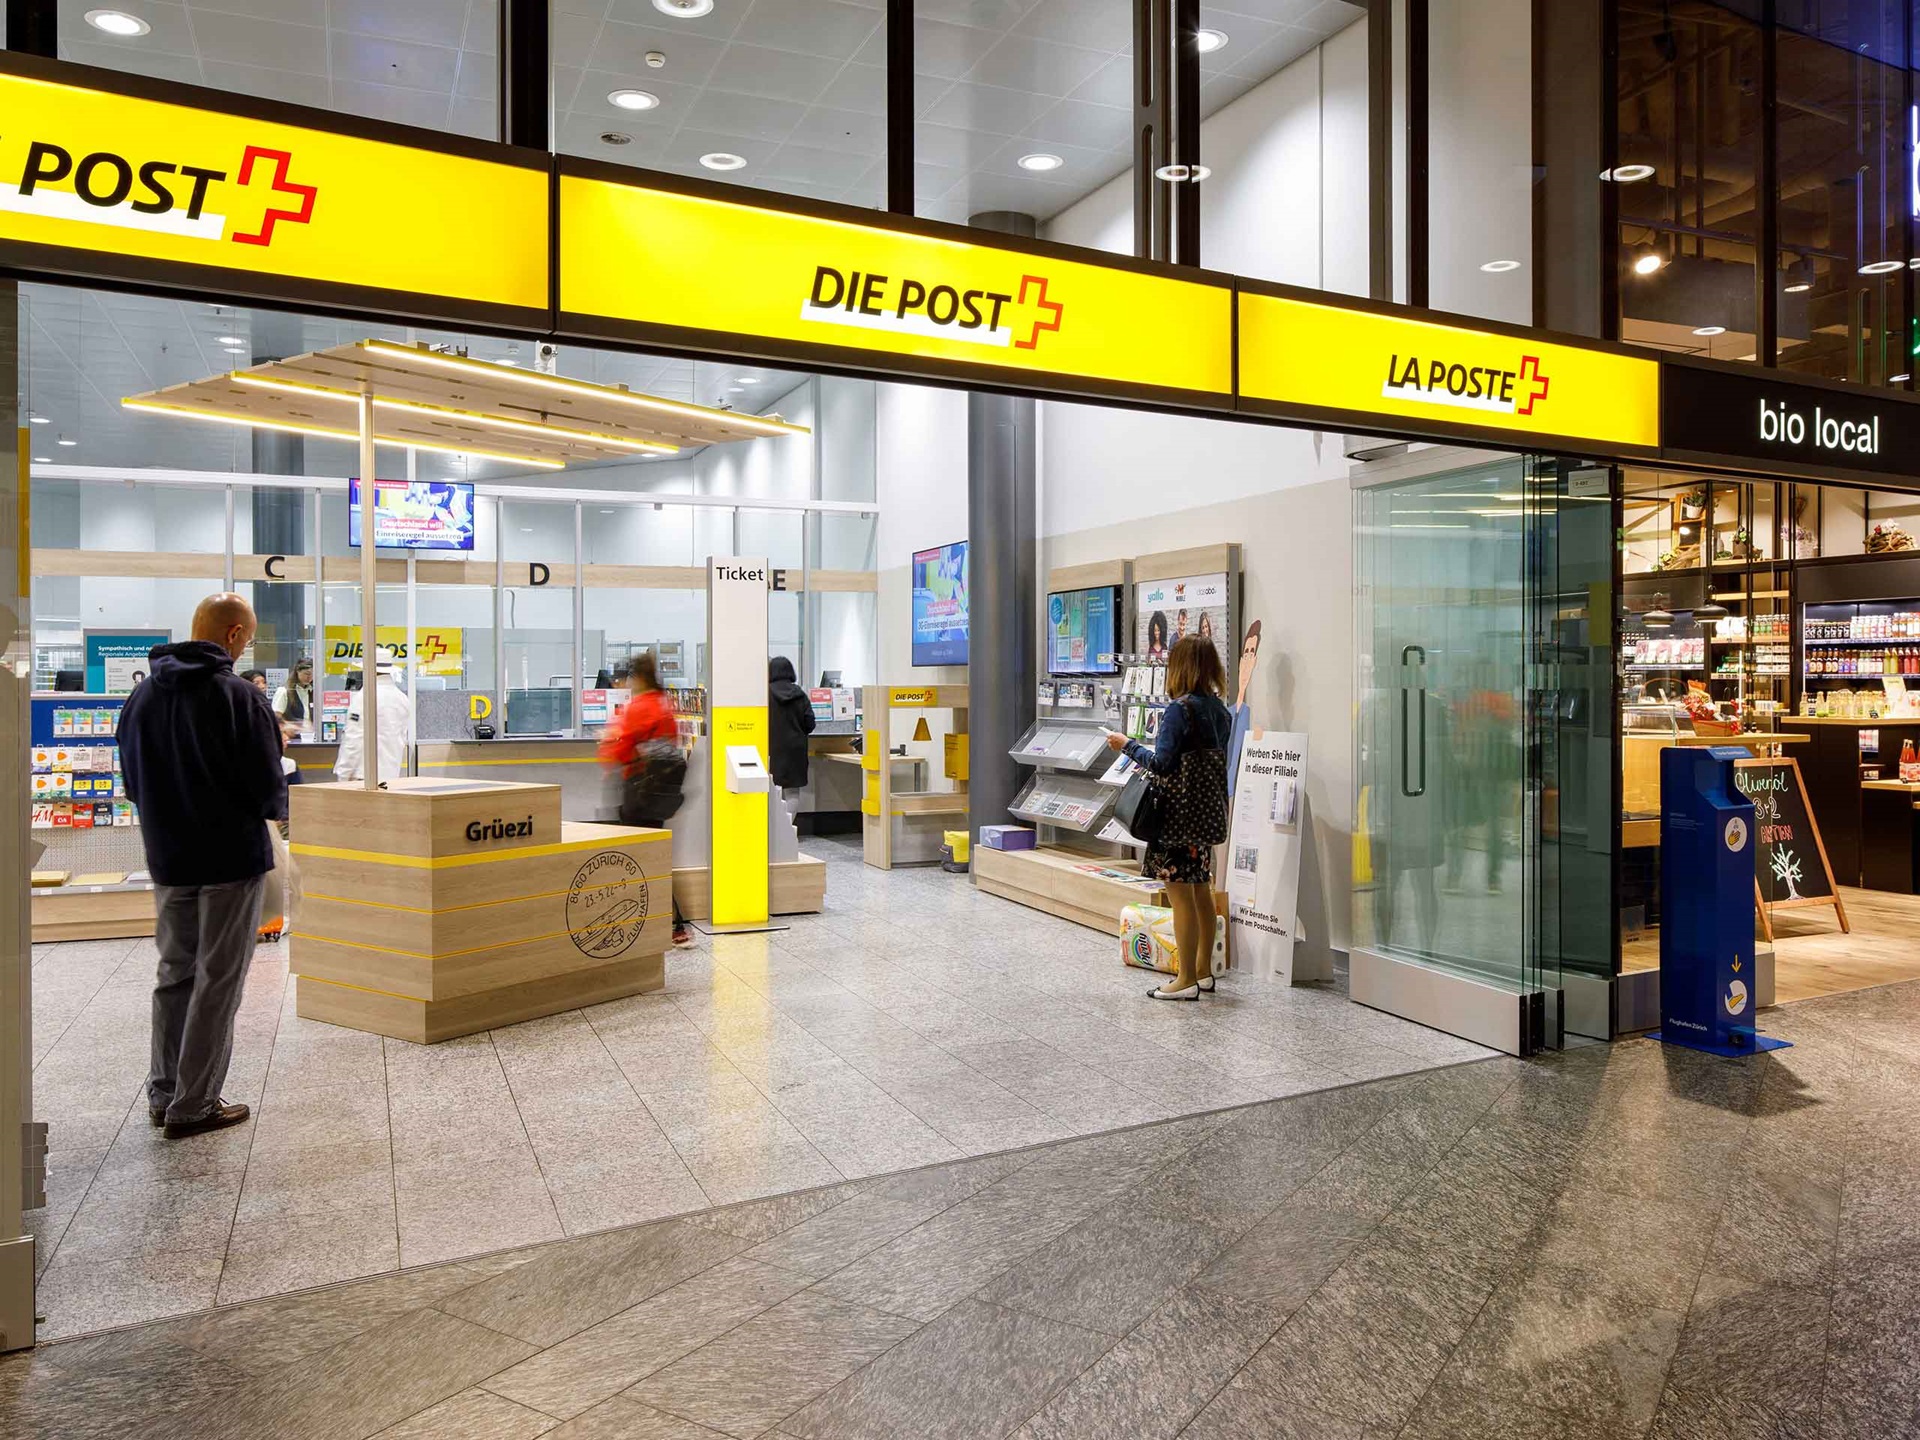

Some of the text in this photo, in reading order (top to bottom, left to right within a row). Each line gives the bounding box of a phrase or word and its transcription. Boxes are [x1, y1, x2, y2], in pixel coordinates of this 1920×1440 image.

[19, 141, 227, 220] POST
[810, 266, 1012, 332] DIE POST
[1388, 354, 1516, 403] LA POSTE
[1760, 399, 1879, 454] bio local
[265, 556, 285, 579] C
[530, 562, 550, 586] D
[716, 566, 764, 581] Ticket
[773, 569, 786, 591] E
[1147, 587, 1164, 603] yallo
[98, 645, 133, 653] Sympathisch
[469, 695, 492, 720] D
[895, 693, 925, 701] DIE POST
[1246, 747, 1301, 762] Werben Sie hier
[1244, 762, 1299, 778] in dieser Filiale
[465, 816, 533, 842] Grüezi
[586, 854, 625, 876] ZÜRICH
[624, 861, 637, 877] 60
[1269, 914, 1279, 924] Sie
[1669, 1018, 1708, 1031] Flughafen Zürich
